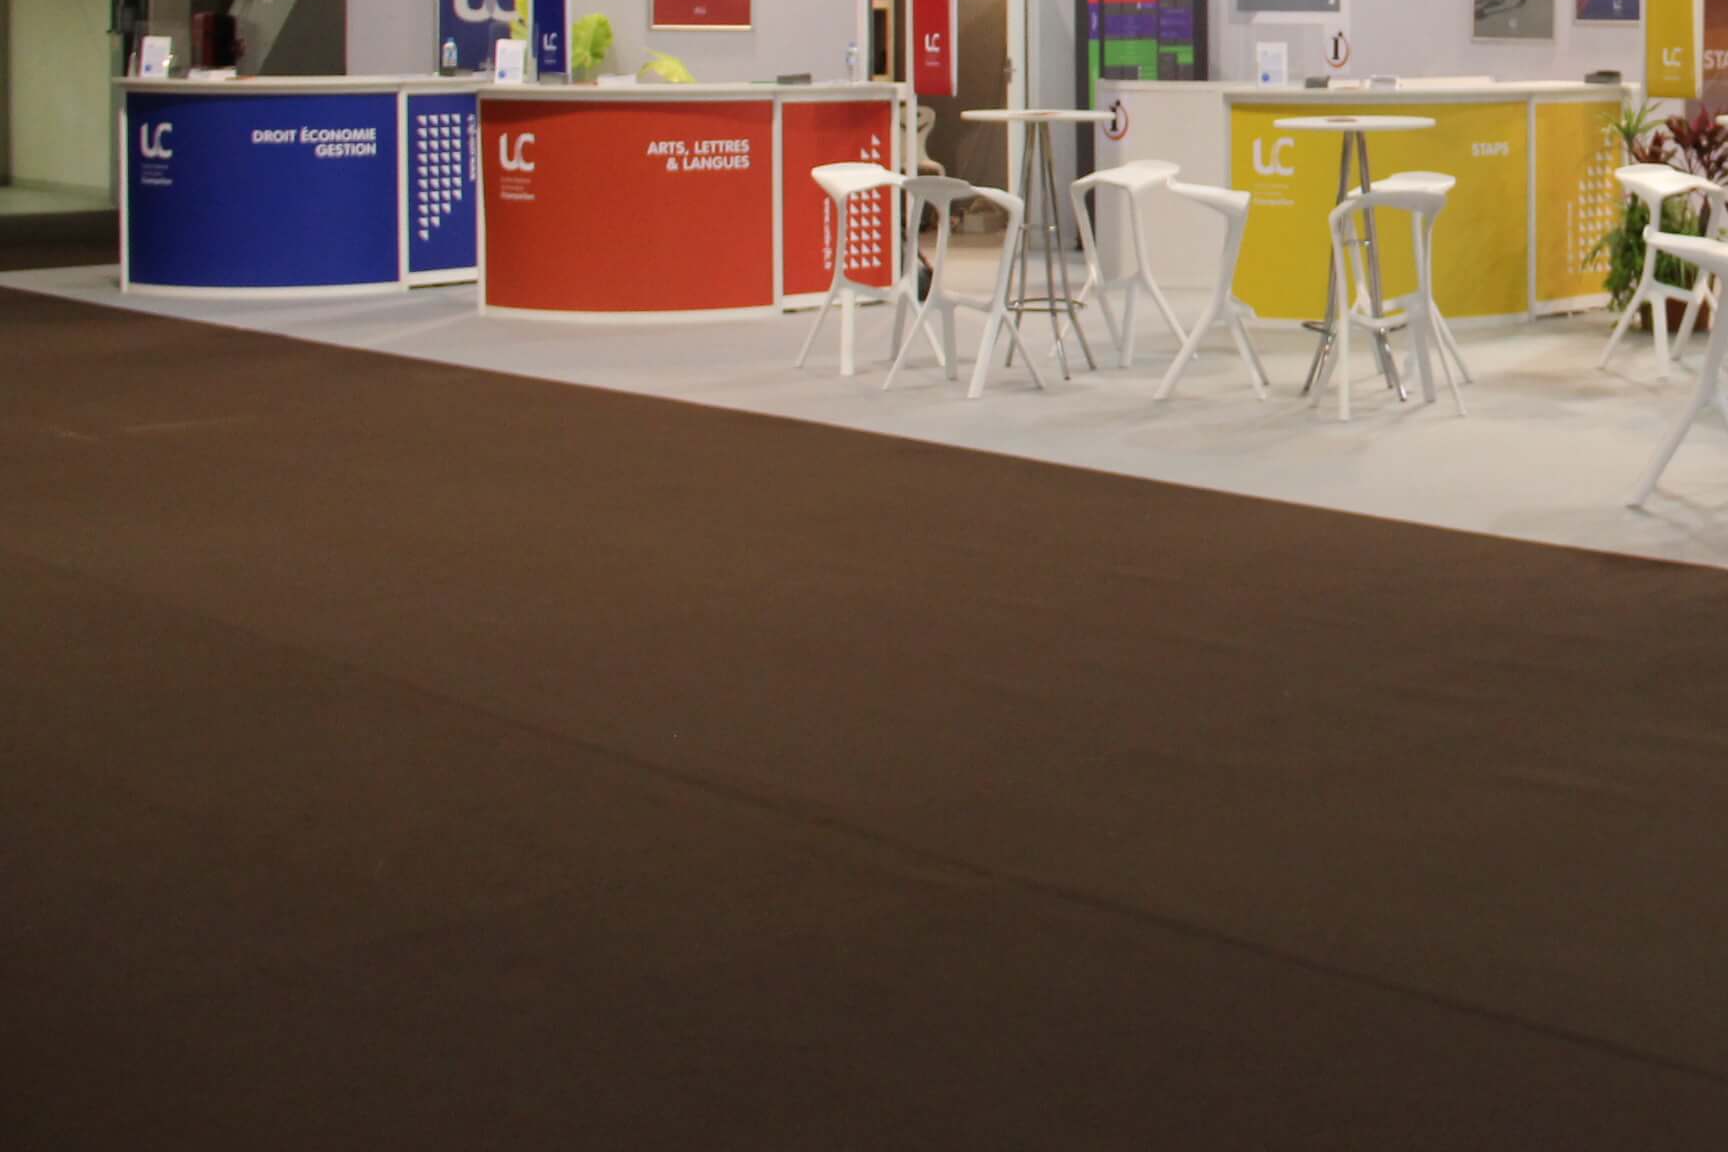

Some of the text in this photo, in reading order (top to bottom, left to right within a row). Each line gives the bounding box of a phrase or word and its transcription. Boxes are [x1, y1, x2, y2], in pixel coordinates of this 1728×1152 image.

[252, 126, 376, 143] DROIT ÉCONOMIE
[315, 142, 376, 158] GESTION
[647, 139, 750, 156] ARTS, LETTRES
[1471, 142, 1510, 158] STAPS
[666, 155, 750, 171] & LANGUES
